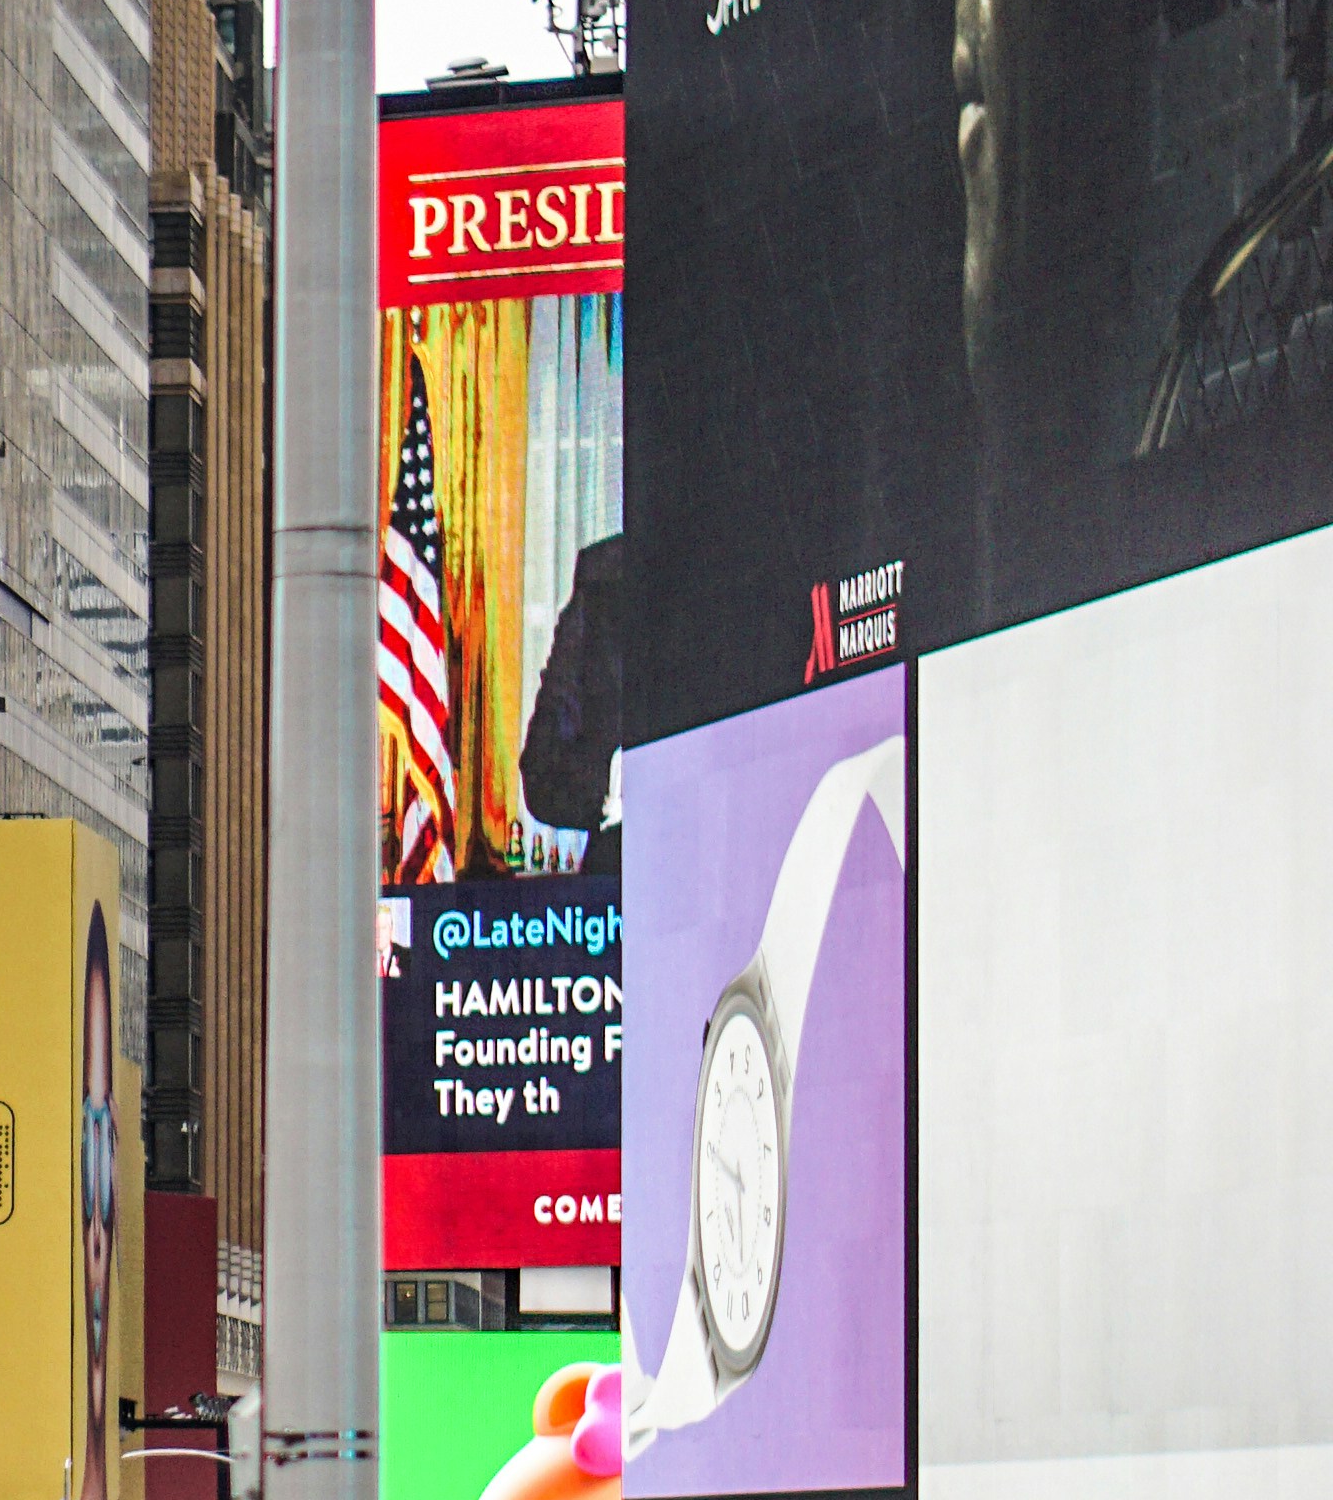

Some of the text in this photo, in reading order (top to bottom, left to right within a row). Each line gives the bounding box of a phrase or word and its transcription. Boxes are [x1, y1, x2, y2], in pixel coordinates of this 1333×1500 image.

[837, 561, 904, 614] MARRIOTT
[837, 606, 896, 661] MARQUIS
[435, 1028, 592, 1074] Founding
[434, 1077, 561, 1125] They th
